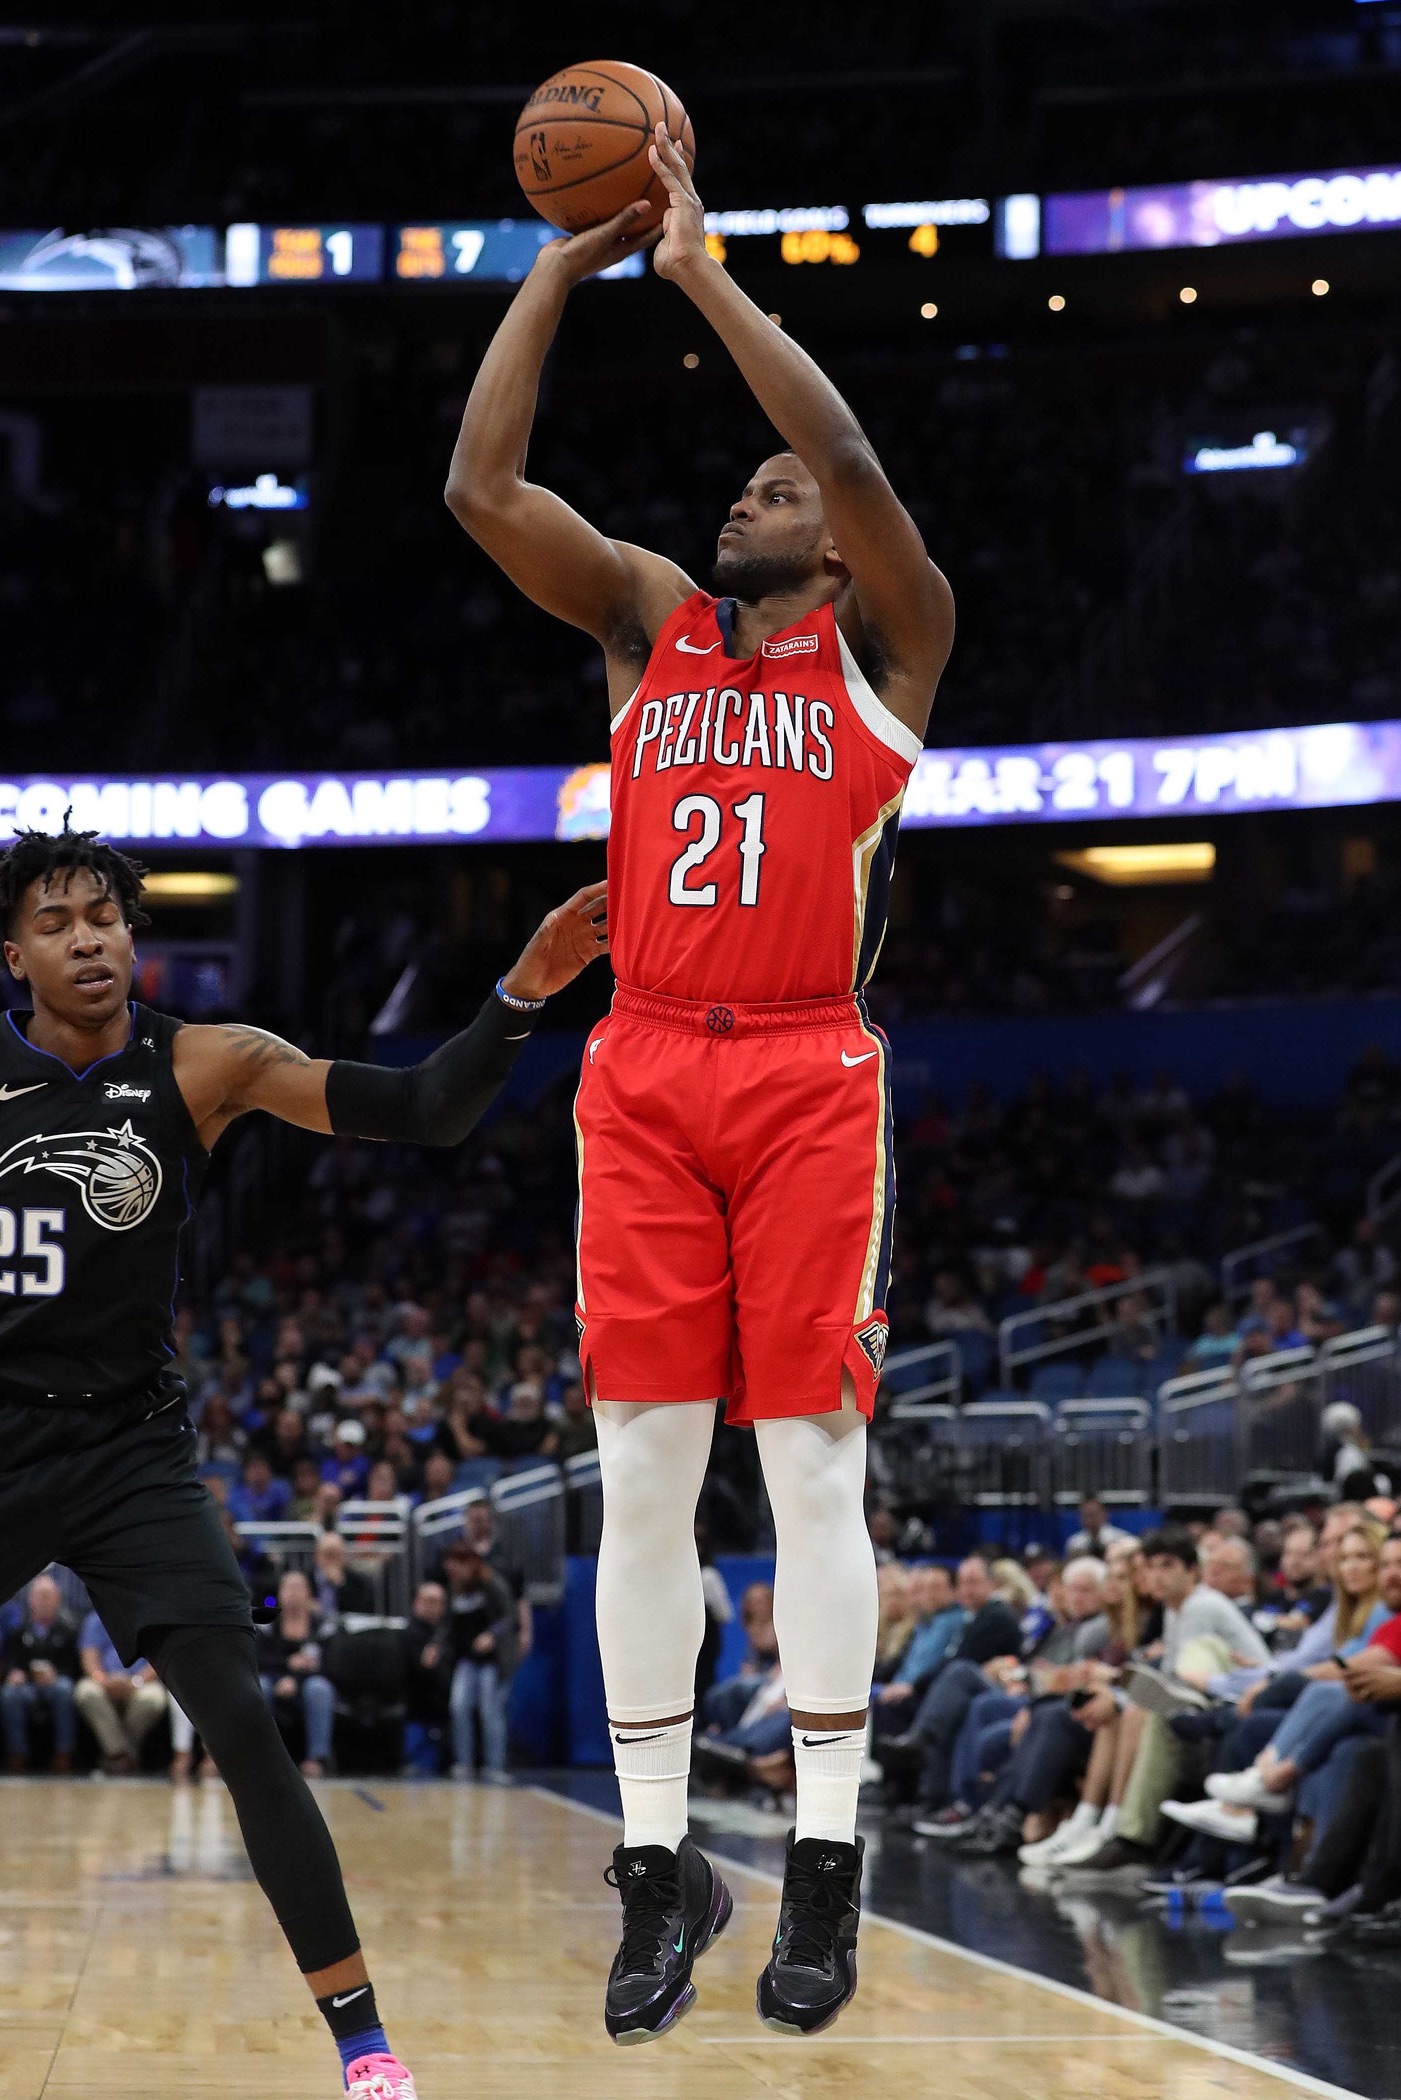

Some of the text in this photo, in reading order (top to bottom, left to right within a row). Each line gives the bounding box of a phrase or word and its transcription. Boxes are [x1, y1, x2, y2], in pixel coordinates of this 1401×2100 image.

[326, 230, 353, 275] 1
[452, 230, 485, 273] 7
[631, 686, 835, 782] PELICANS
[1153, 738, 1296, 804] 7PM
[258, 777, 490, 838] GAMES
[668, 792, 766, 907] 21
